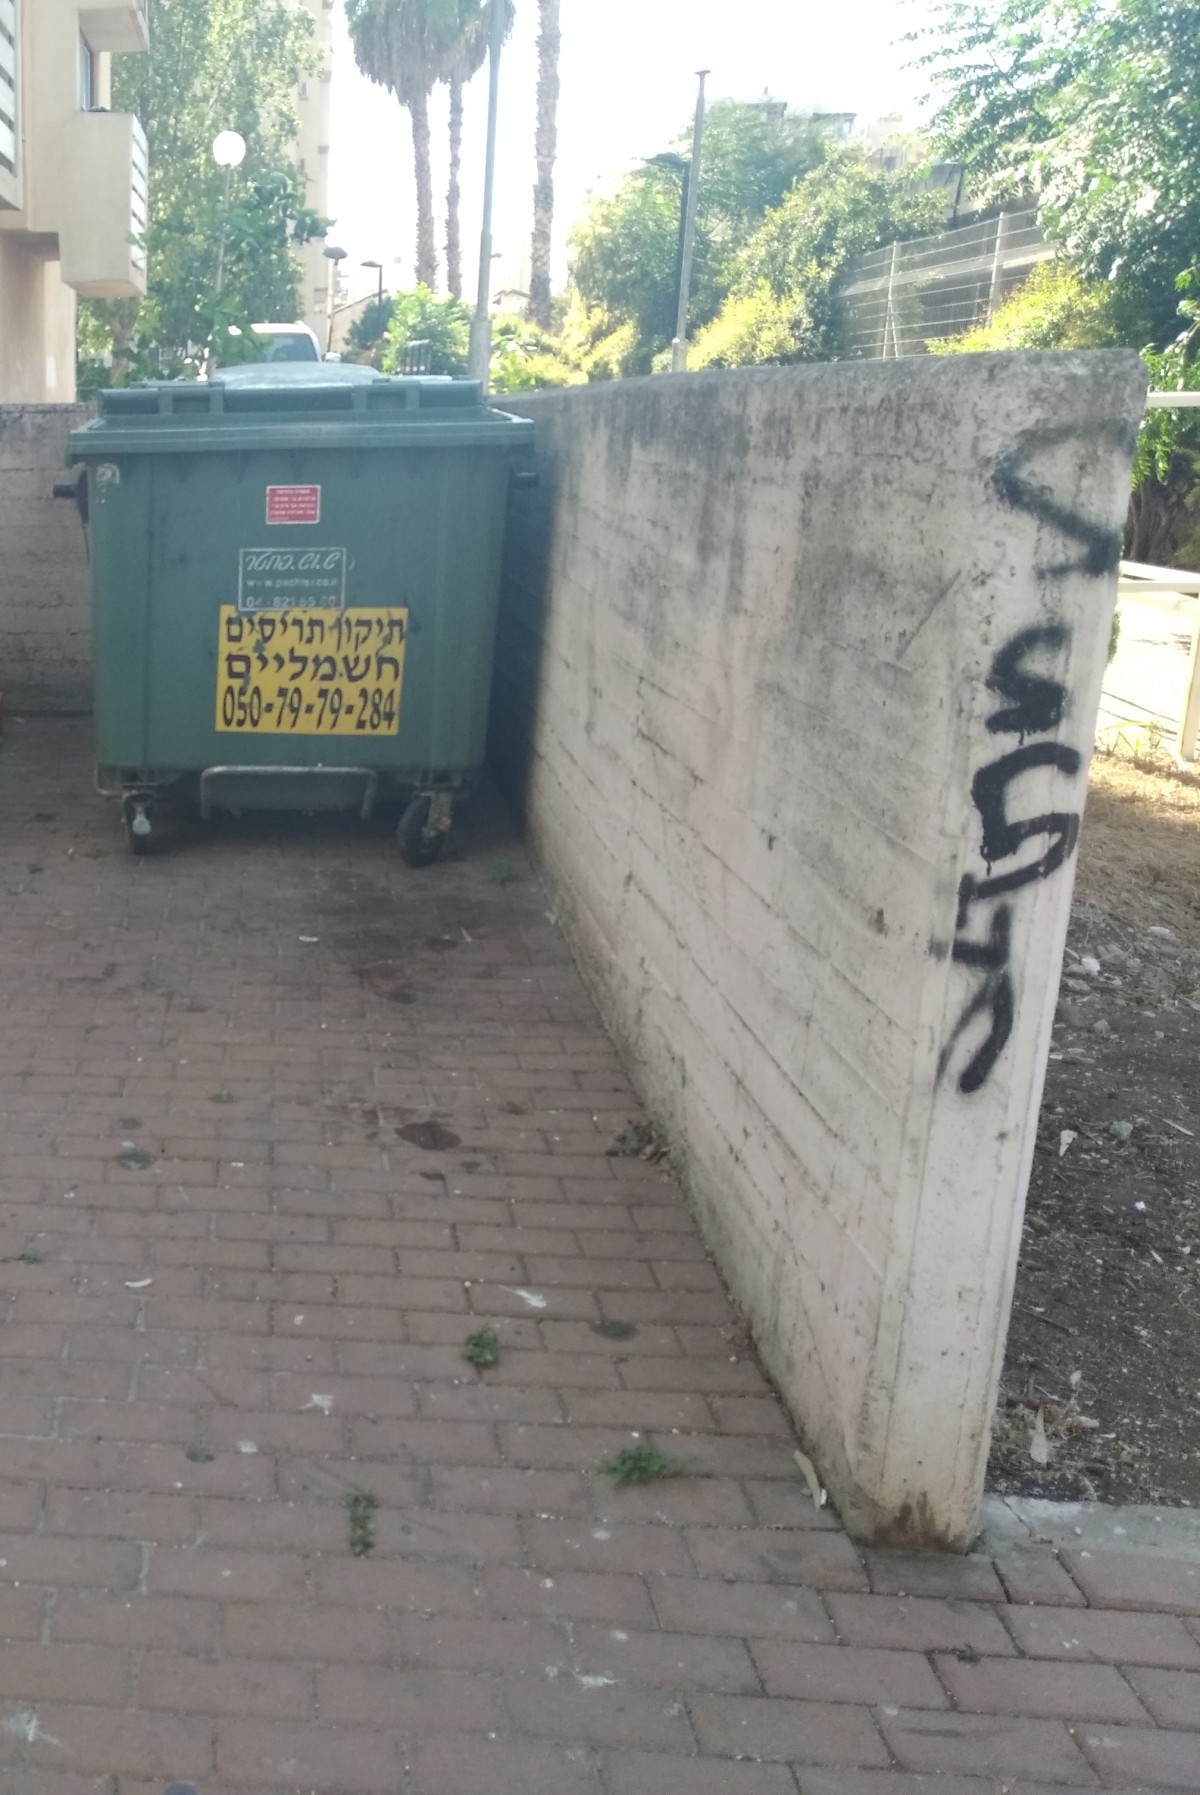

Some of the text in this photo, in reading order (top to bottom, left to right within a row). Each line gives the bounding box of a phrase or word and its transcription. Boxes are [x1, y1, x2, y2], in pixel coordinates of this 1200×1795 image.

[226, 615, 406, 653] תיקון תריסים
[225, 646, 400, 683] חשמליים
[222, 685, 396, 731] 050-79-79-284
